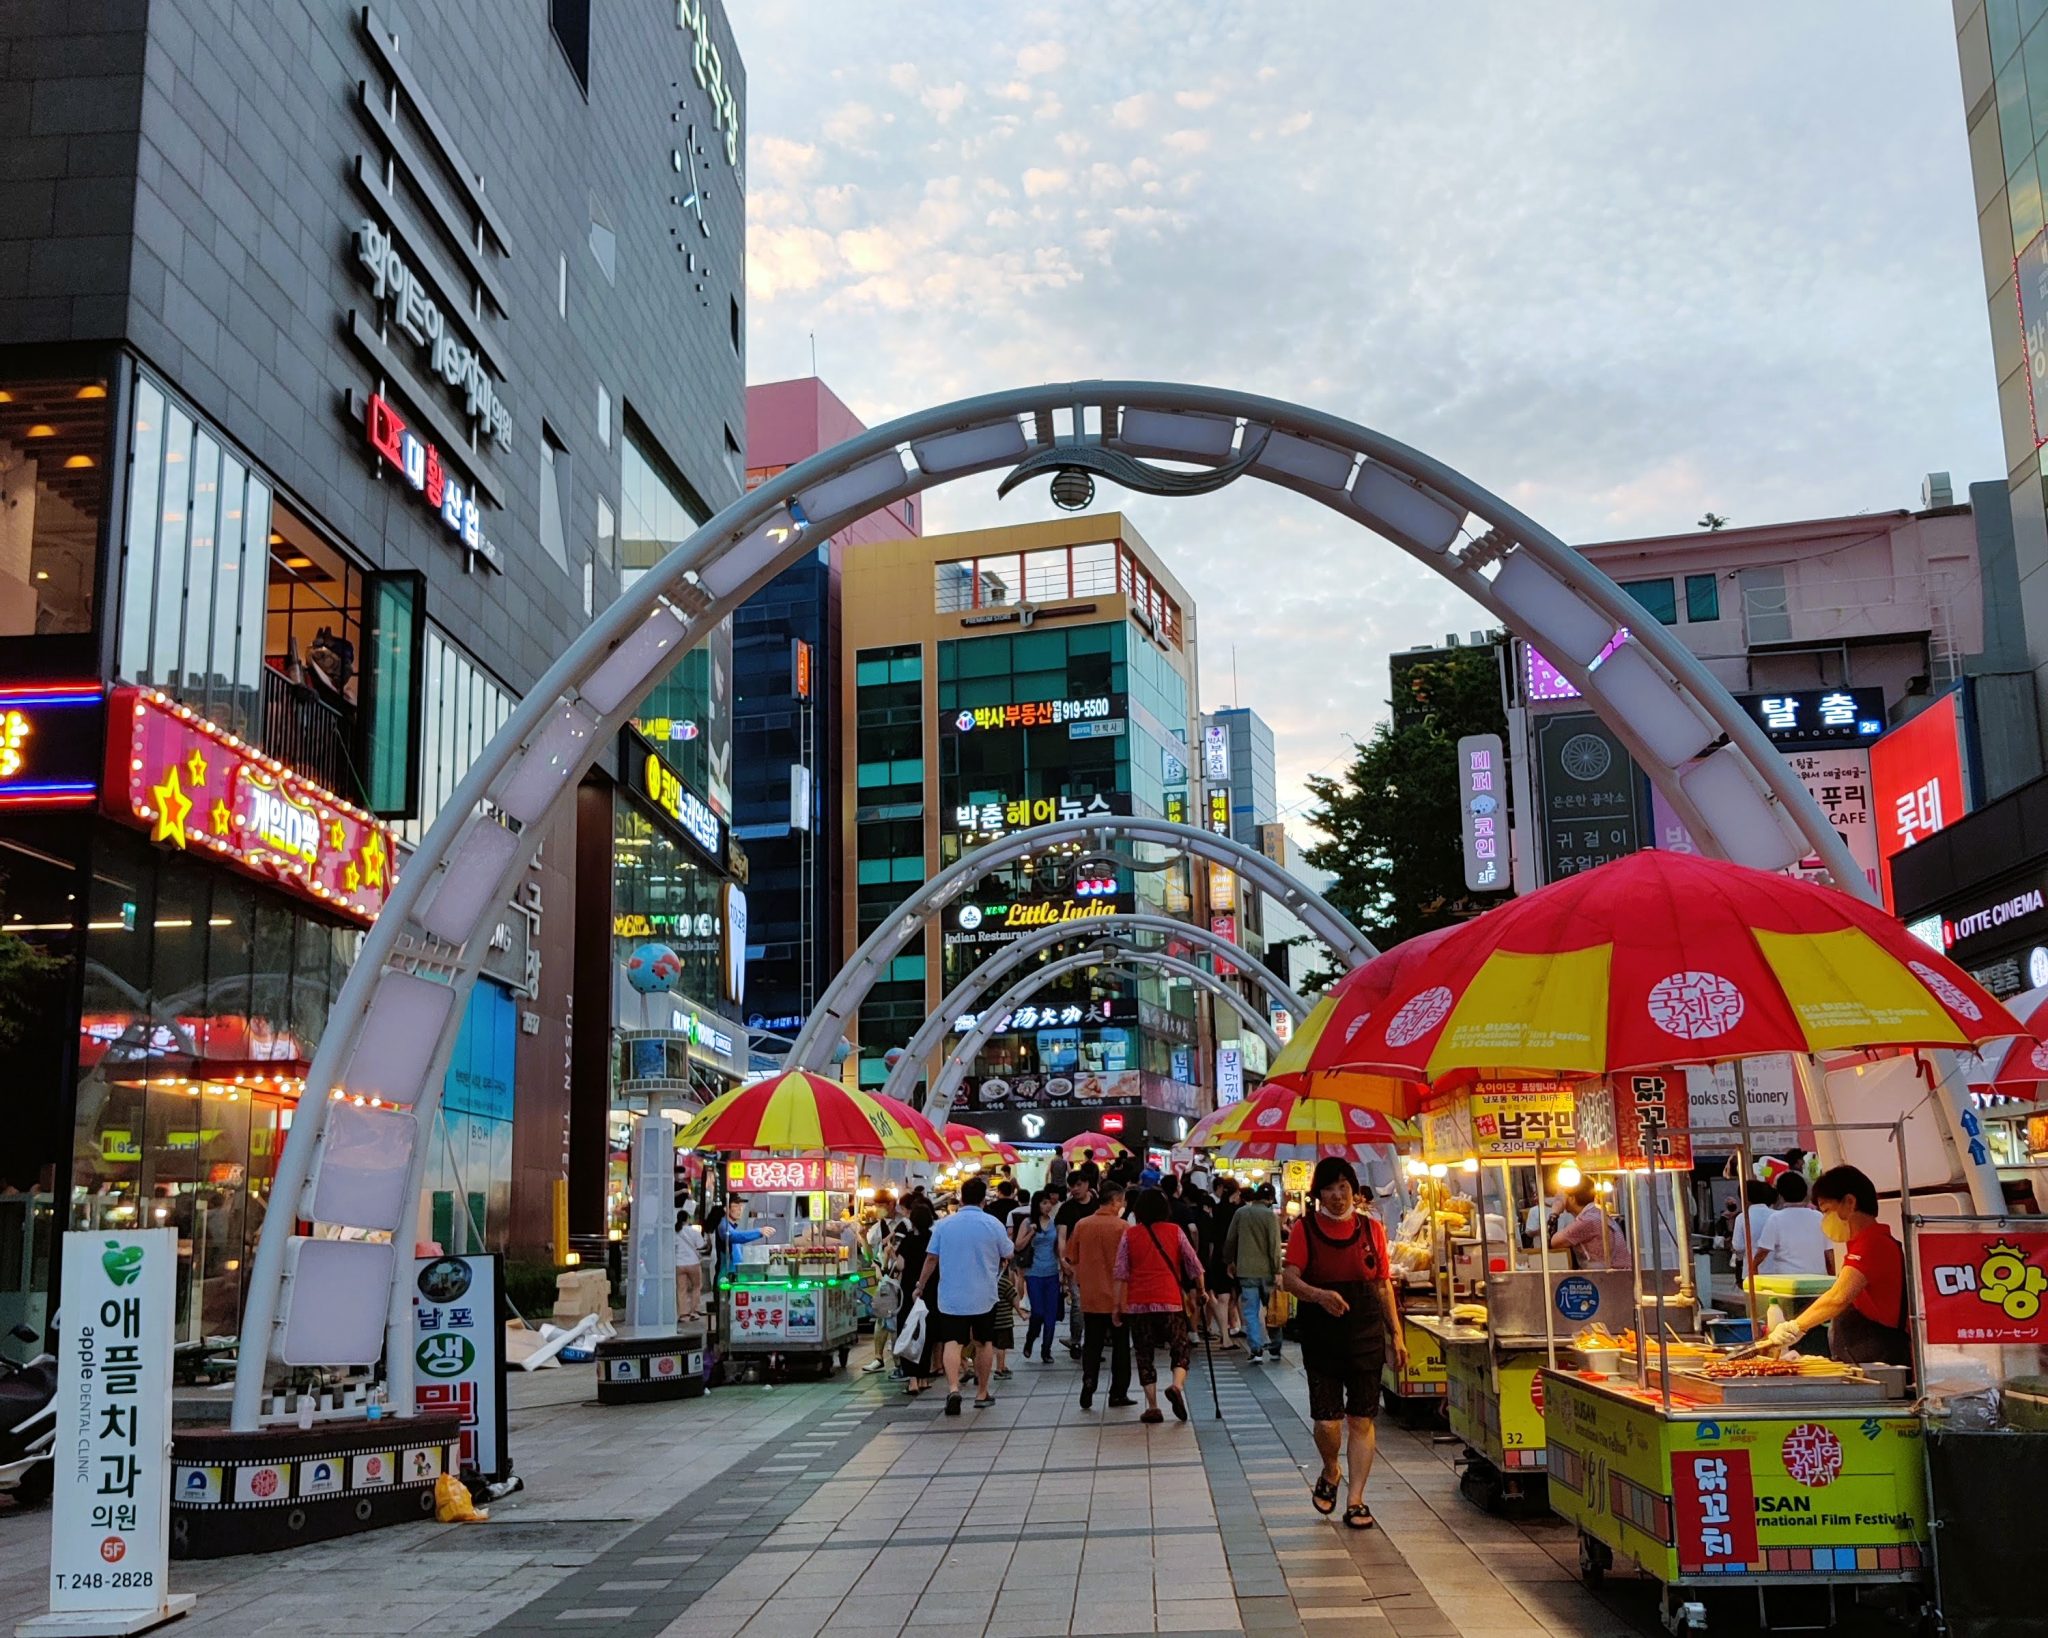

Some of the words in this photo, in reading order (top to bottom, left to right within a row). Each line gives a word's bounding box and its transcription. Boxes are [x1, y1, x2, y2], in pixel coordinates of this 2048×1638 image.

[1063, 698, 1109, 719] 919-5500
[1553, 794, 1585, 808] 은은한
[1591, 792, 1625, 806] 공작소
[1896, 777, 1943, 848] 롯데
[1829, 812, 1866, 824] CAFE
[1474, 817, 1495, 859] 코인
[1005, 902, 1059, 927] Little
[1060, 899, 1117, 922] India
[1955, 910, 1992, 940] LOTTE
[1992, 889, 2043, 925] CINEMA
[489, 922, 512, 951] NG
[945, 932, 976, 945] Indian
[1688, 1091, 1719, 1105] ooks
[1728, 1090, 1788, 1106] Stionery
[747, 1162, 805, 1188] 탕후루
[1933, 1255, 2048, 1320] 대왕
[417, 1308, 474, 1331] 남포
[735, 1307, 784, 1329] 탕후루
[78, 1326, 97, 1379] apple
[79, 1383, 92, 1437] DENTAL
[1506, 1432, 1524, 1445] 32
[77, 1438, 90, 1483] CLINIC
[91, 1504, 136, 1531] 의원
[1693, 1457, 1732, 1557] 닭꼬치
[1821, 1513, 1851, 1525] Film
[102, 1541, 123, 1557] 5F
[72, 1572, 153, 1590] 248-2828
